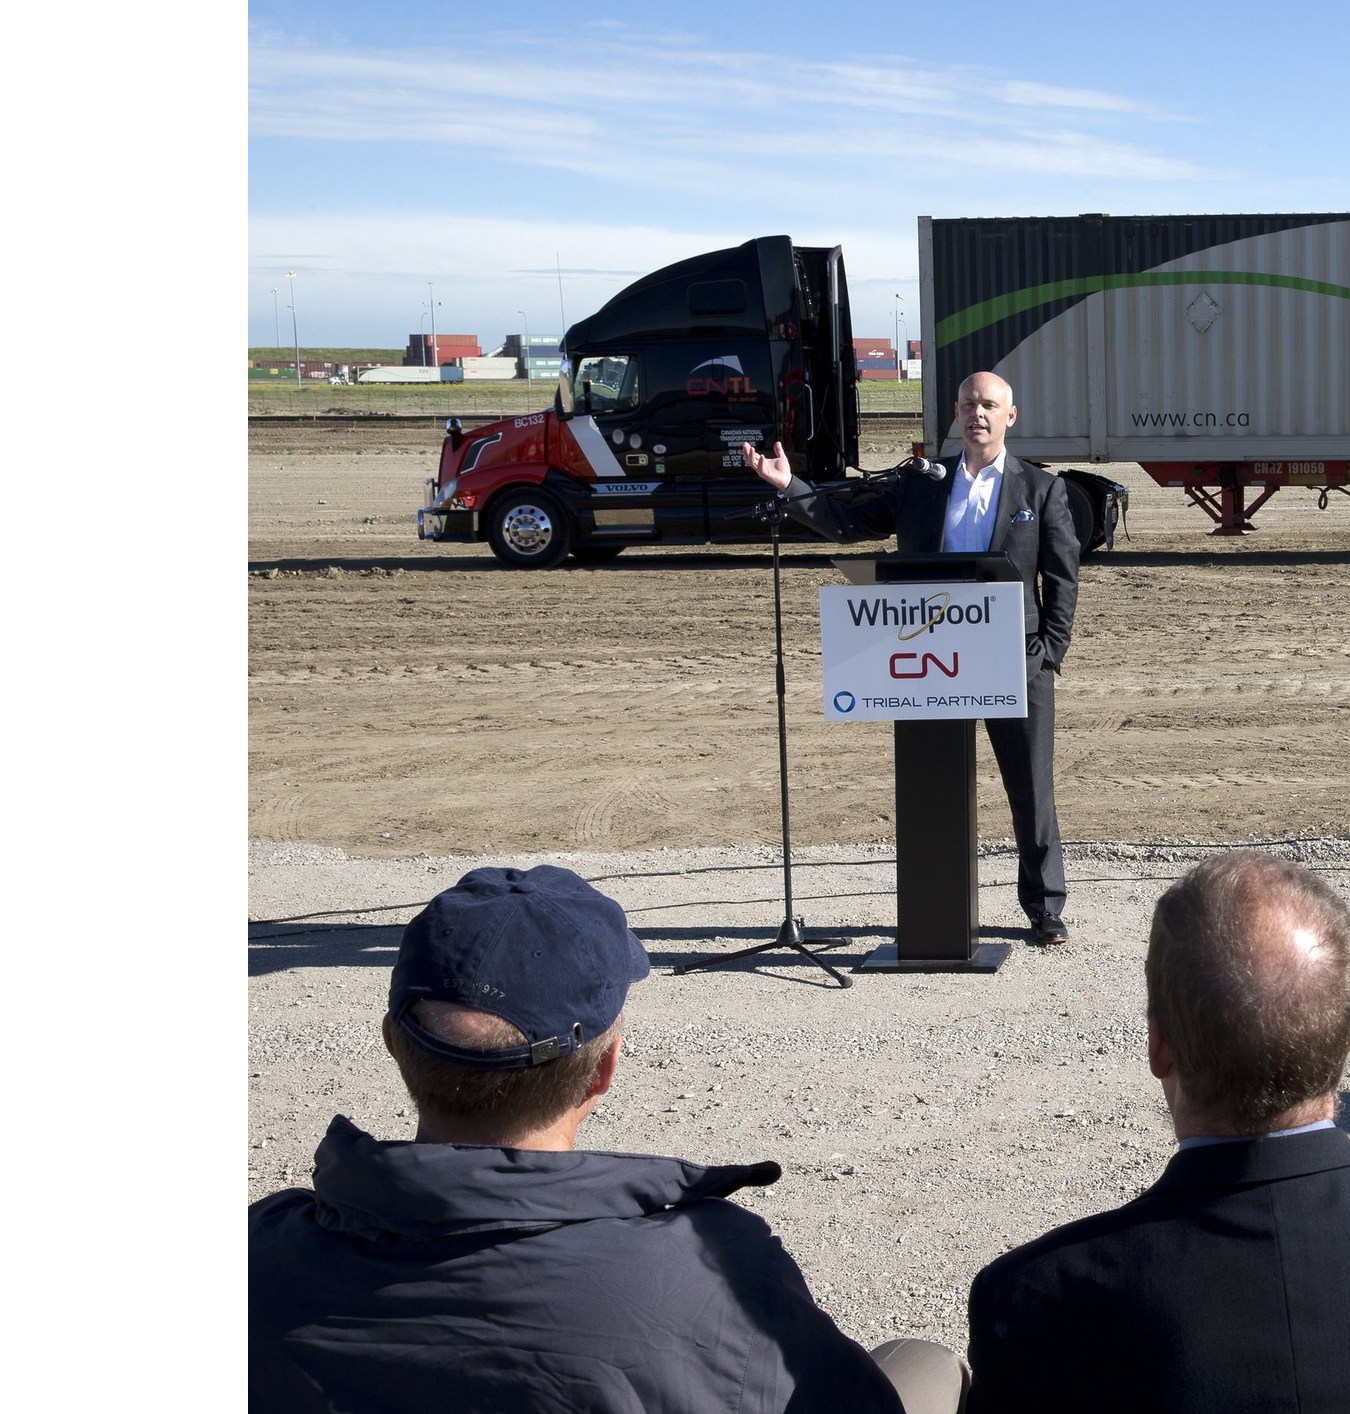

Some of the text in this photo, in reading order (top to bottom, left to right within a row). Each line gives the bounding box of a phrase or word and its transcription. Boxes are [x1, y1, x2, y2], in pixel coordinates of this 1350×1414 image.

[687, 377, 758, 395] CNTL
[514, 413, 545, 428] BC132
[1131, 412, 1250, 427] www.cn.ca
[1287, 462, 1325, 474] 191059
[605, 484, 648, 492] VOLVO
[889, 651, 959, 679] CN
[862, 694, 1017, 708] TRIBAL PARTNERS
